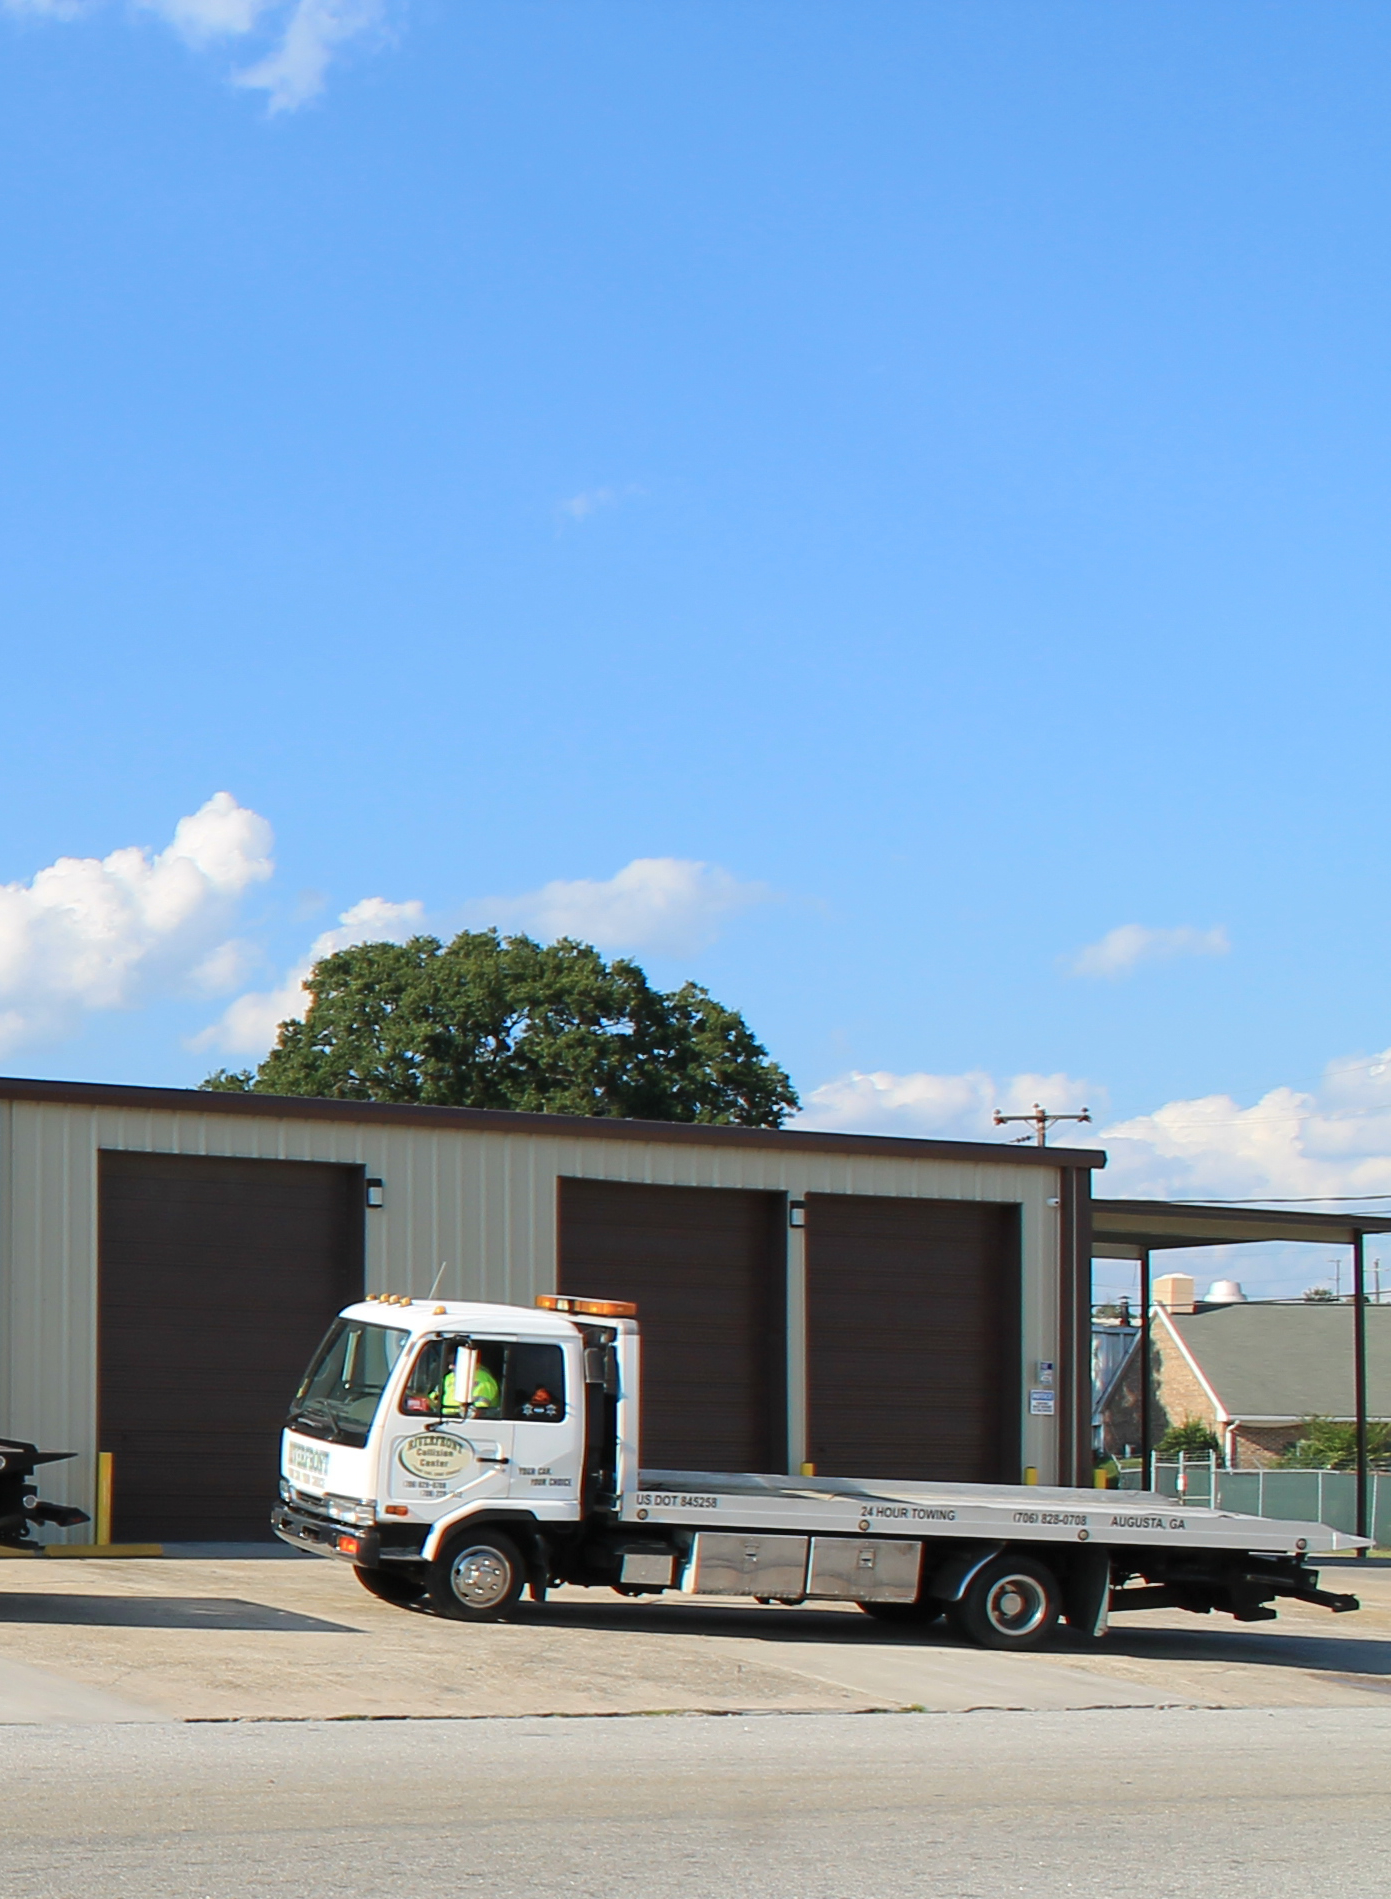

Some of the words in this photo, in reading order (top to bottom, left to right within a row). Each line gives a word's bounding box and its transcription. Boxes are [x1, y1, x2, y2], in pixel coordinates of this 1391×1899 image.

[407, 1435, 464, 1455] RIVERFRONT
[416, 1448, 454, 1457] Collision
[419, 1459, 449, 1467] Center
[636, 1494, 651, 1505] US
[654, 1495, 678, 1506] DOT
[680, 1496, 718, 1508] 845258
[861, 1506, 874, 1517] 24
[876, 1507, 908, 1518] HOUR
[911, 1509, 956, 1521] TOWING
[1013, 1512, 1039, 1524] (706)
[1041, 1513, 1087, 1526] 828-0708
[1110, 1516, 1166, 1530] AUGUSTA,
[1169, 1518, 1186, 1530] GA
